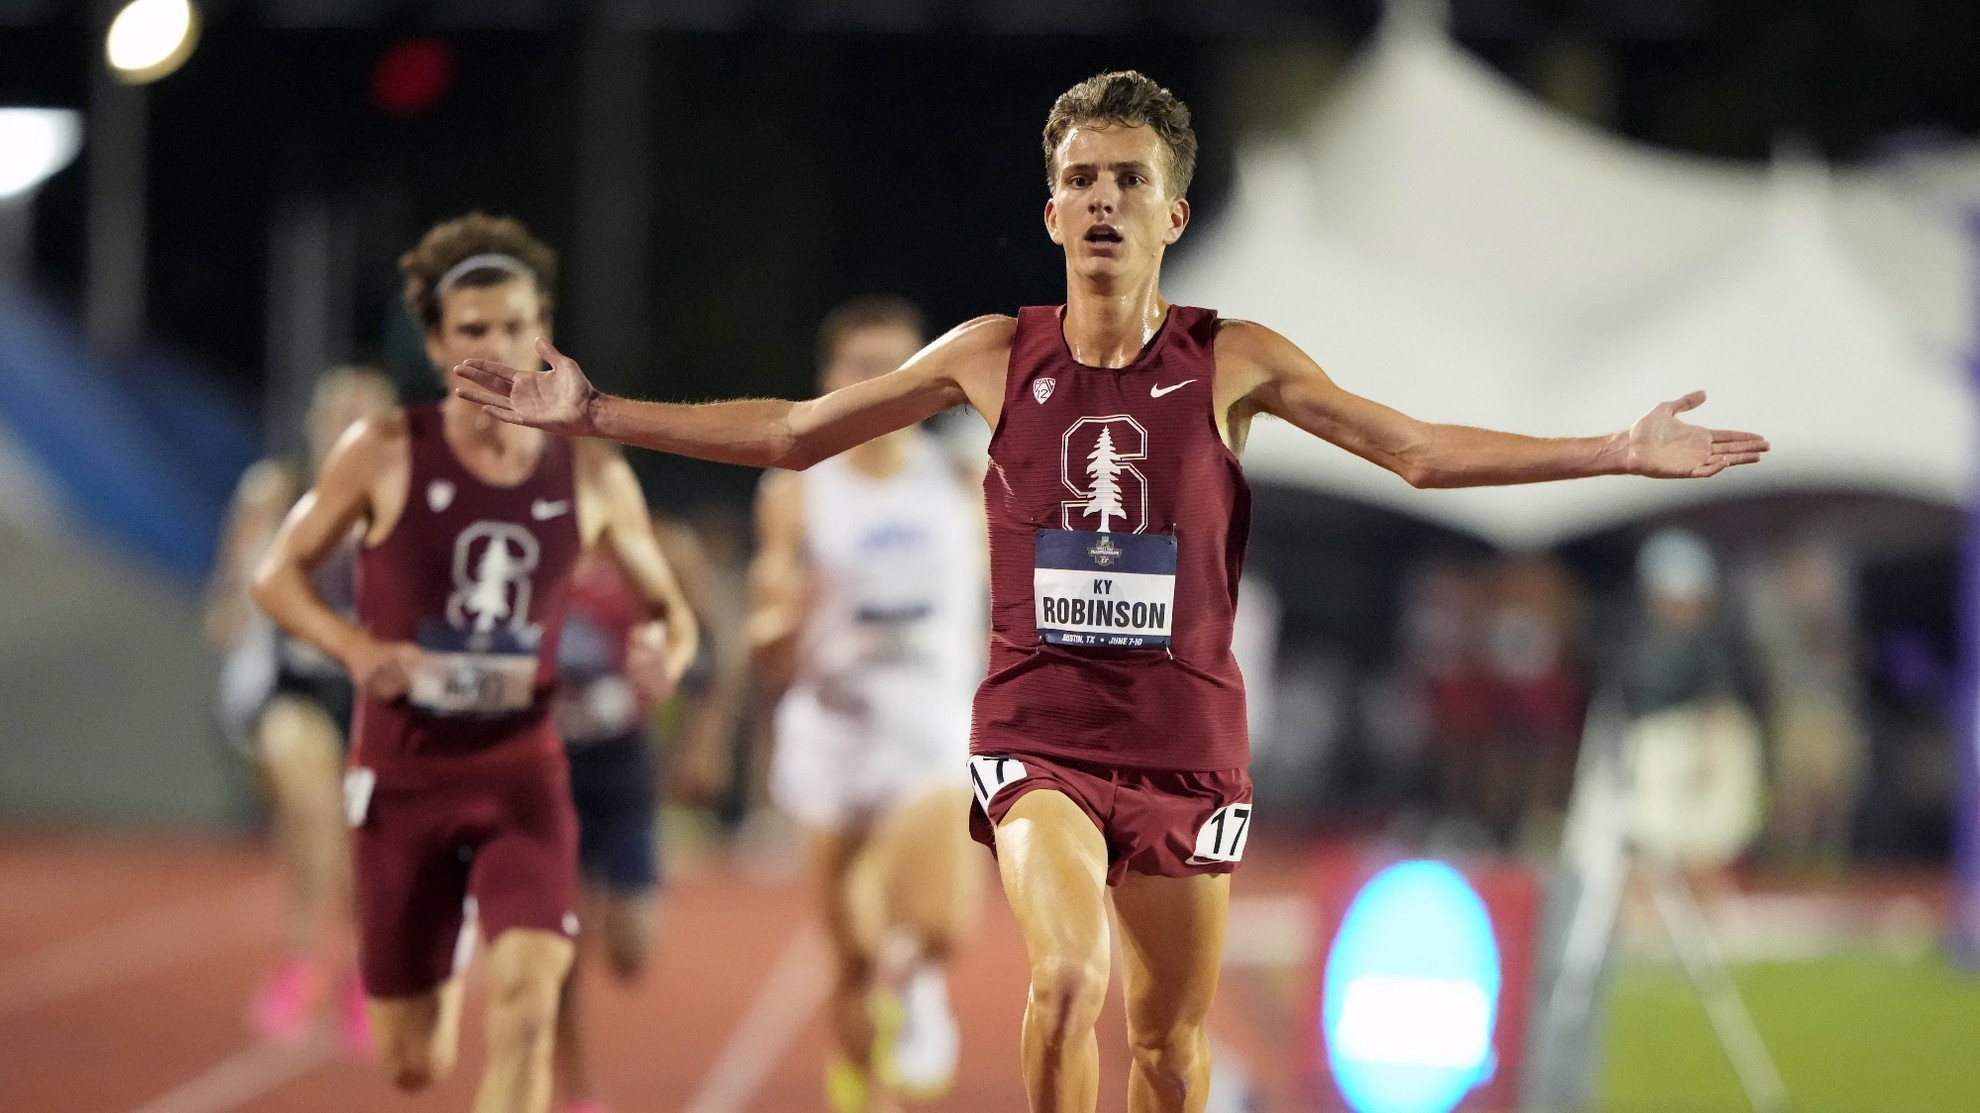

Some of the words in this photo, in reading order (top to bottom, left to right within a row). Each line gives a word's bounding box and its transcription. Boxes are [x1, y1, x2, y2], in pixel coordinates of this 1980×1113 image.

[1036, 389, 1049, 399] 12
[1093, 579, 1113, 595] KY
[1043, 596, 1166, 629] ROBINSON
[1062, 633, 1084, 644] AUSTIN,
[1086, 635, 1096, 644] TX
[1108, 637, 1127, 645] JUNE
[1128, 638, 1143, 646] 7-10
[969, 757, 1010, 801] 17
[1210, 807, 1250, 857] 17
